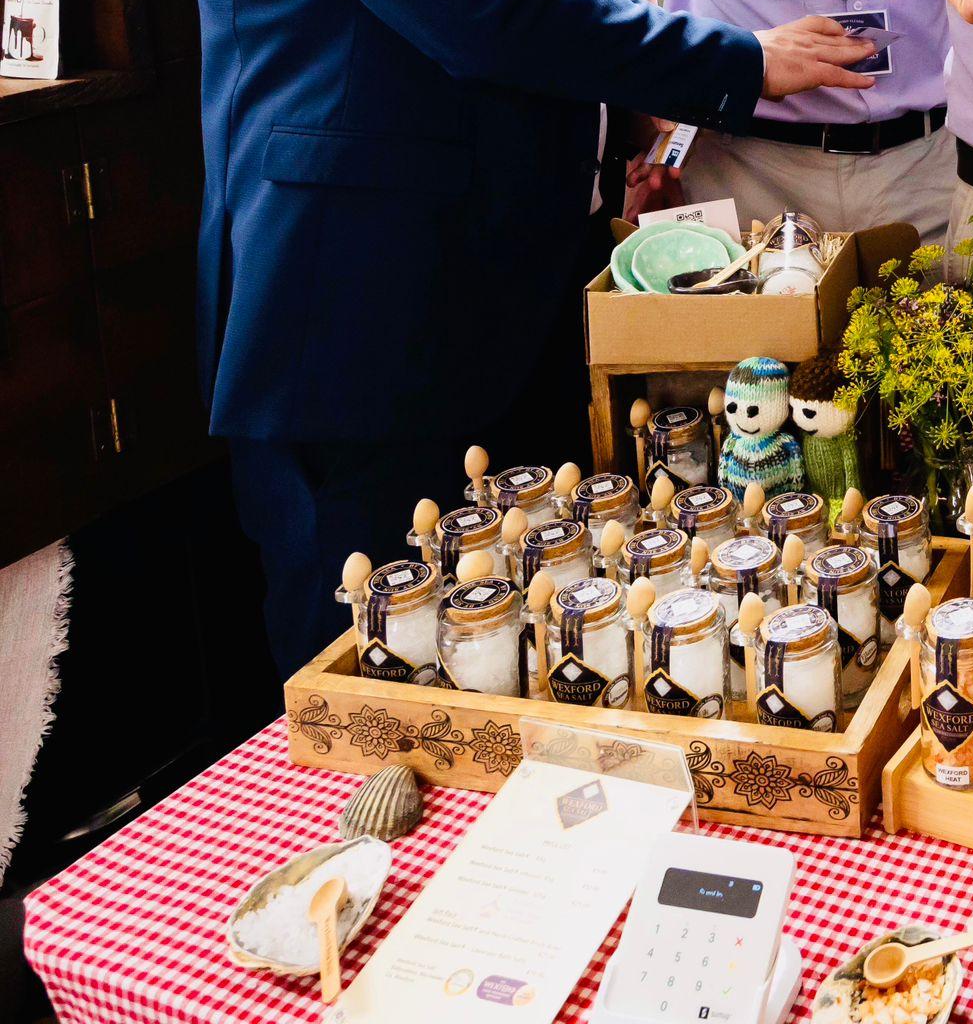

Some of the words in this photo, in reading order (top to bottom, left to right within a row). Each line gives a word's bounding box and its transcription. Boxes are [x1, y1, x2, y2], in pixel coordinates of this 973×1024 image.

[931, 718, 947, 731] SEA
[947, 725, 969, 733] SALT
[938, 767, 968, 777] WEXFORD
[945, 775, 961, 783] HEAT
[655, 924, 660, 934] 1
[680, 928, 688, 939] 2
[708, 932, 716, 943] 3
[647, 947, 654, 958] 4
[675, 951, 681, 962] 5
[702, 955, 709, 967] 6
[640, 970, 647, 982] 7
[667, 976, 675, 987] 8
[695, 980, 702, 991] 9
[660, 1000, 668, 1012] 0
